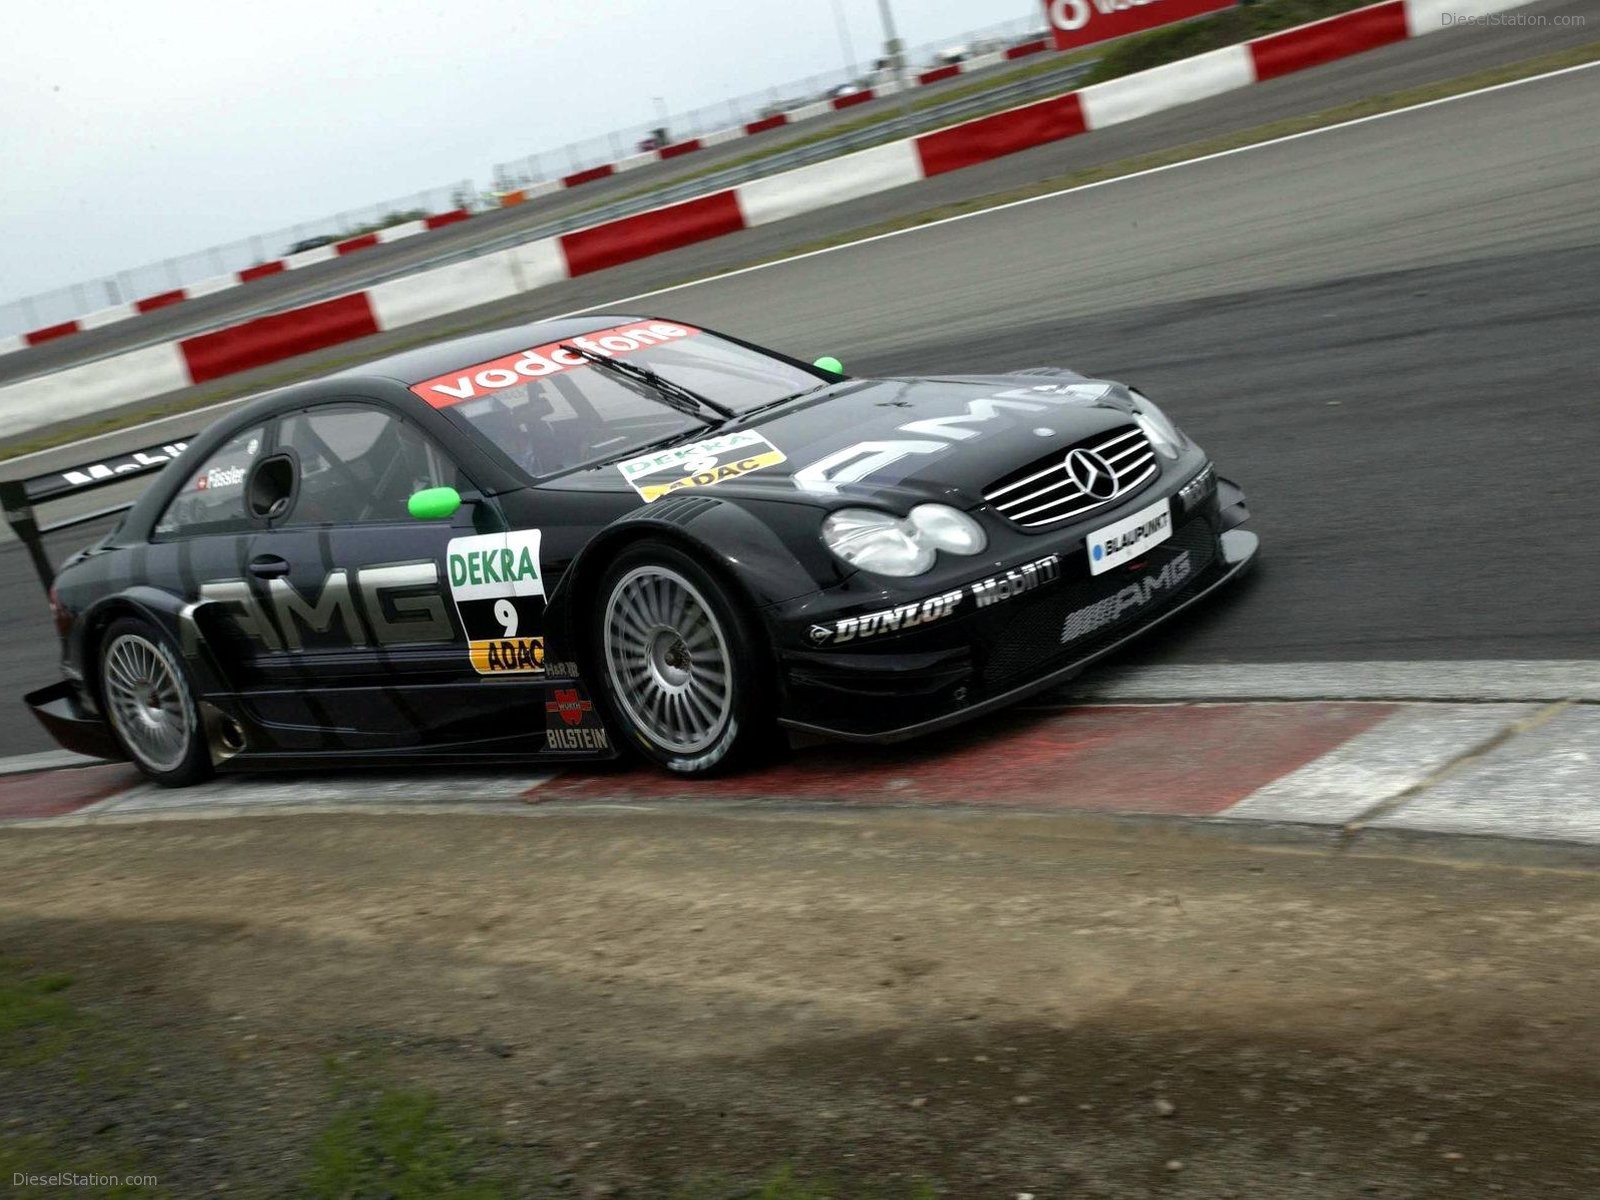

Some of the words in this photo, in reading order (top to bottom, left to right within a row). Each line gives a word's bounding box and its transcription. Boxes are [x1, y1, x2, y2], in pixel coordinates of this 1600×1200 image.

[432, 323, 688, 400] vodafone
[1104, 510, 1170, 556] BLAUPUNKT
[449, 546, 538, 588] DEKRA
[494, 599, 519, 638] 9
[833, 589, 964, 644] DUNLOP
[971, 562, 1037, 608] Mobil
[488, 639, 544, 671] ADAC
[546, 729, 608, 748] BILSTEIN
